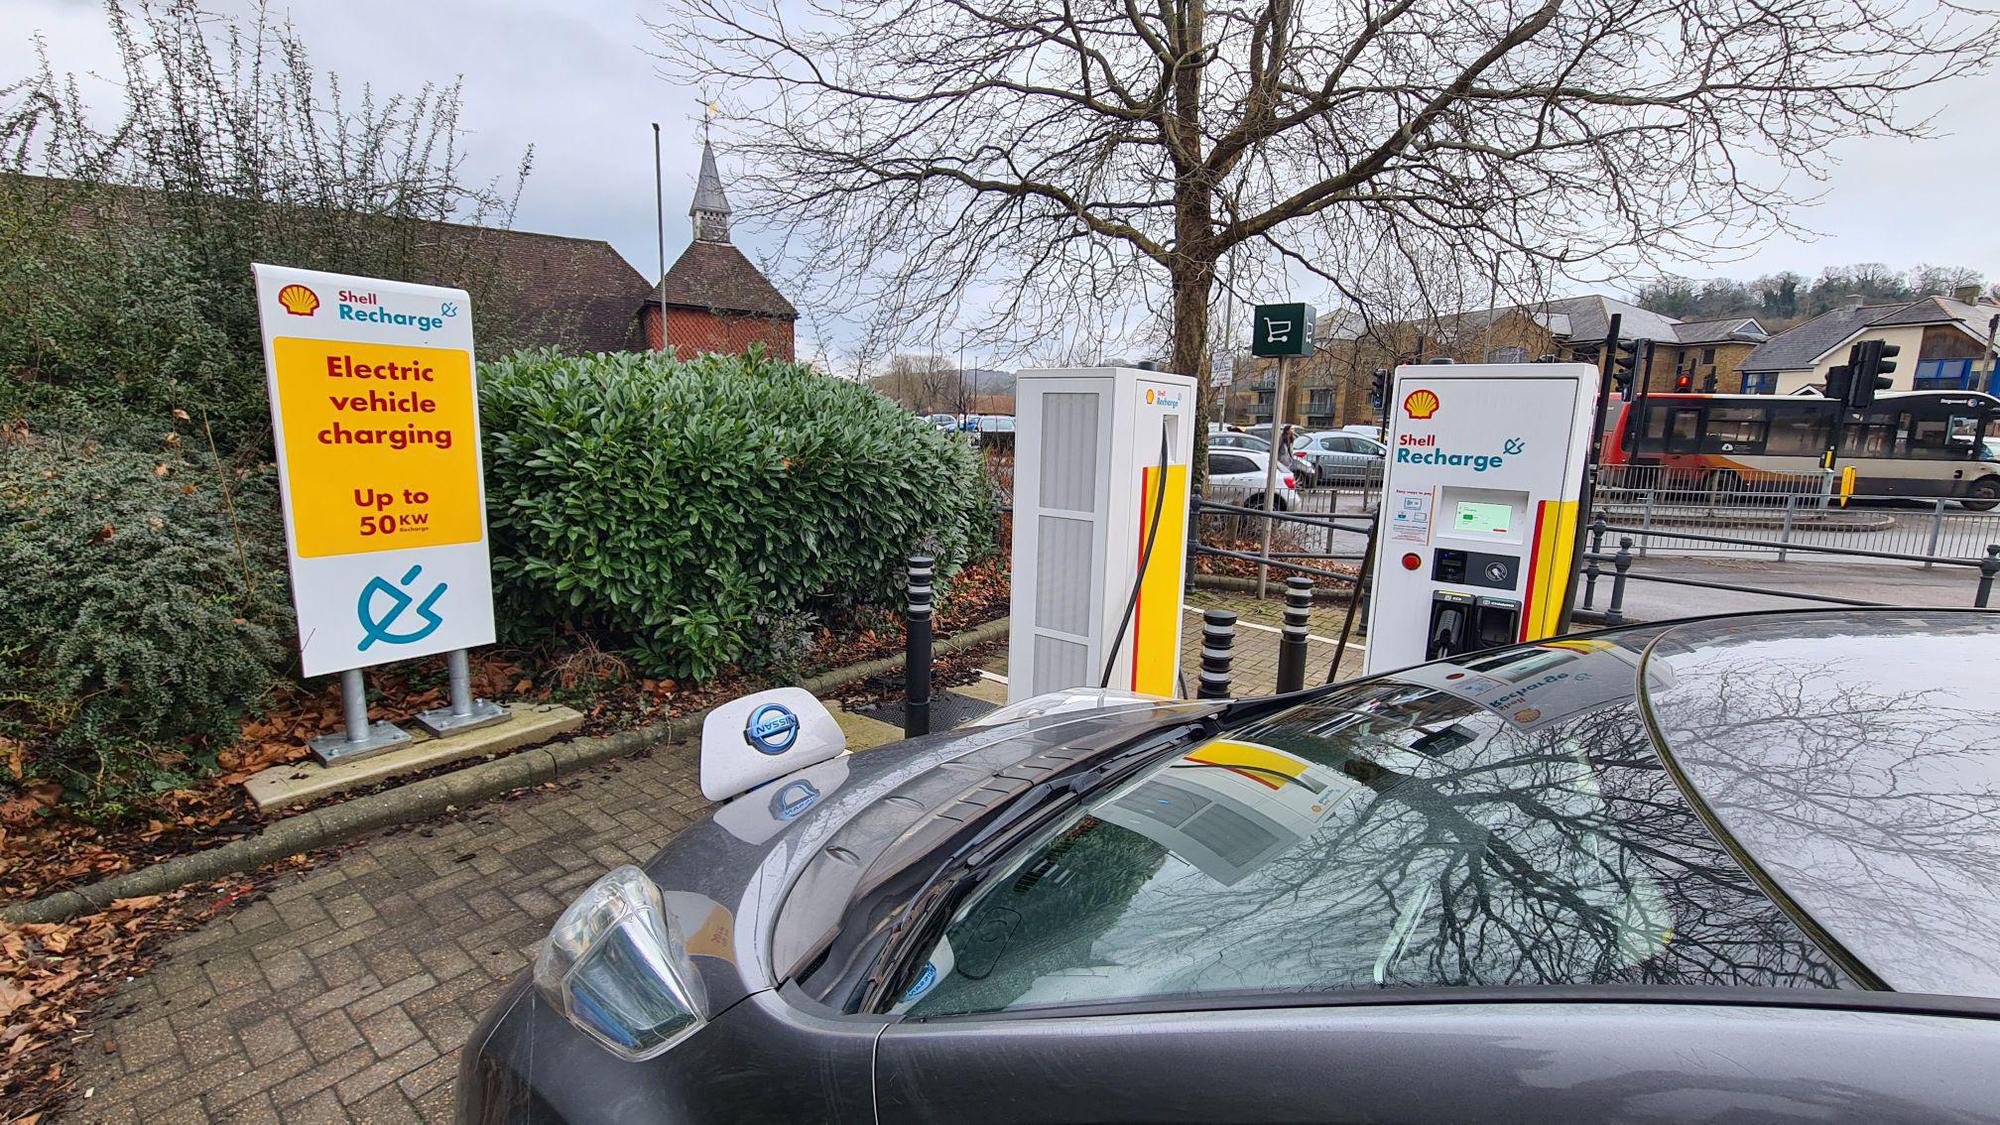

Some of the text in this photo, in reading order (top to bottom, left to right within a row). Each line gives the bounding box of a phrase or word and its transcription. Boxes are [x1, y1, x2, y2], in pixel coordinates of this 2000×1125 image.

[339, 290, 377, 305] Shell
[339, 304, 443, 332] Recharge
[327, 355, 434, 382] Electric
[329, 390, 436, 413] vehicle
[318, 422, 452, 450] charging
[1400, 433, 1436, 447] Shell
[1397, 448, 1503, 472] Recharge
[354, 489, 429, 512] Up to
[360, 513, 429, 536] 50 KW
[756, 716, 795, 735] NISSAN
